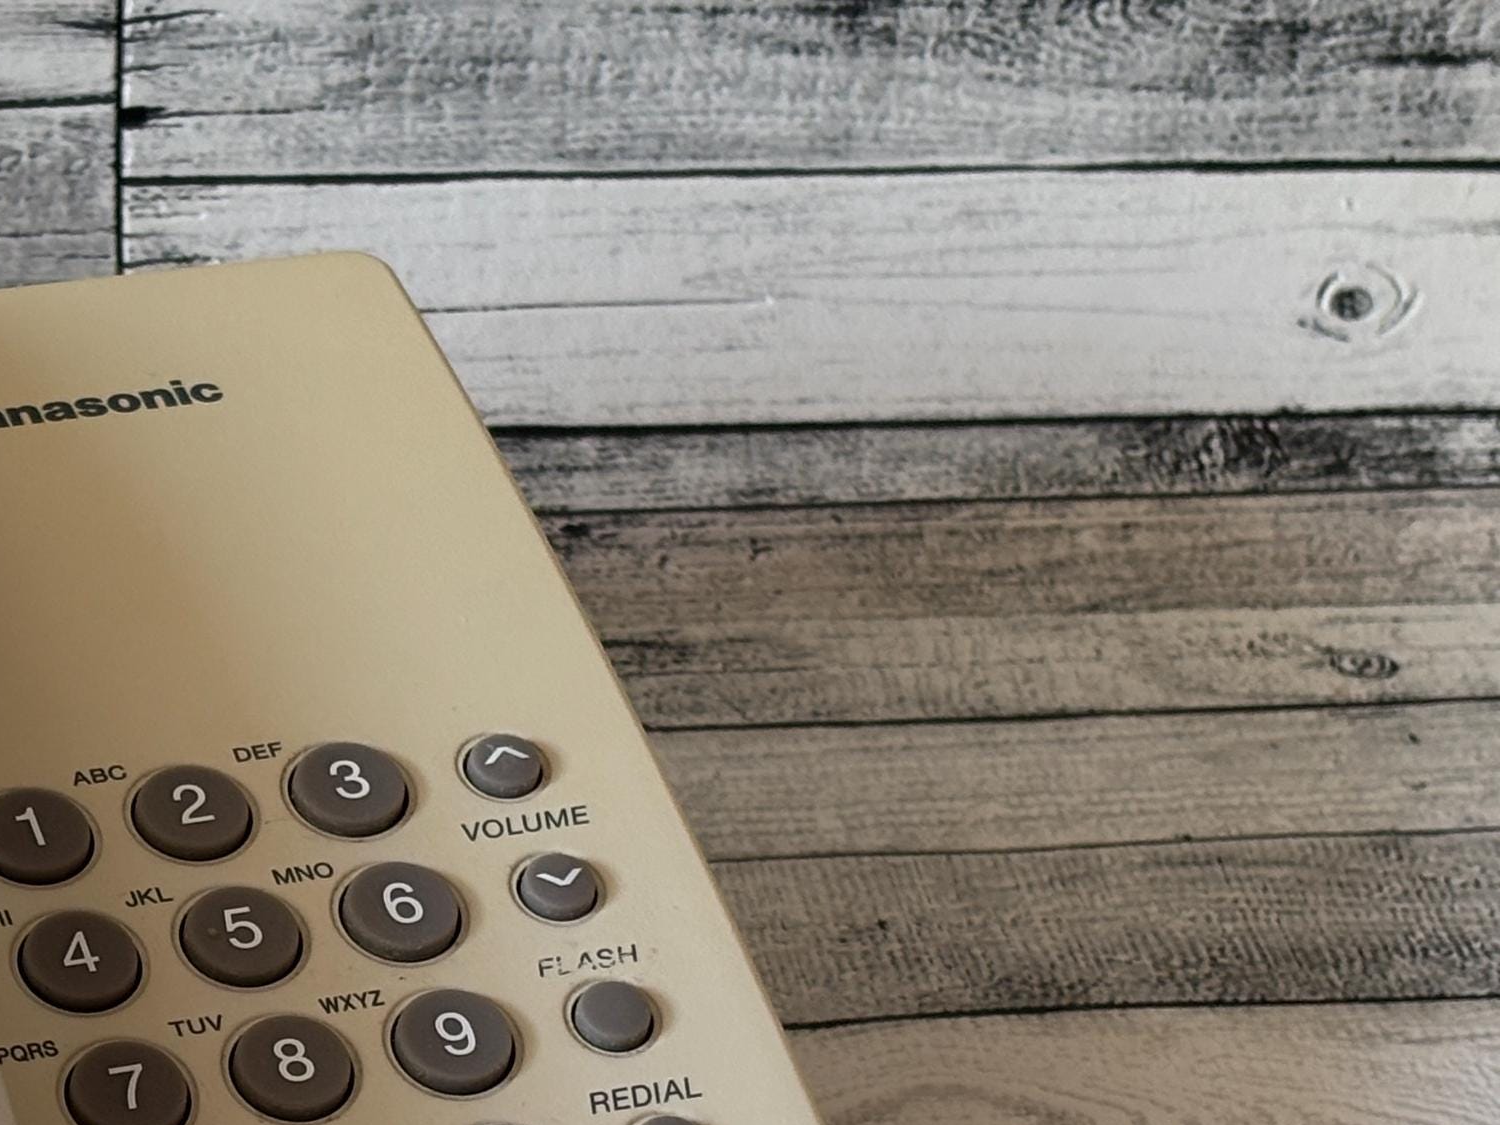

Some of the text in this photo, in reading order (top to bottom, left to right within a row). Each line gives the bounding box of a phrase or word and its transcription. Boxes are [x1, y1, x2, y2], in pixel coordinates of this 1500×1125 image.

[233, 742, 281, 762] DEF
[74, 765, 126, 786] ABC
[330, 761, 369, 798] 3
[173, 785, 214, 824] 2
[16, 807, 45, 845] 1
[461, 806, 589, 841] VOLUME
[272, 863, 333, 885] MNO
[126, 888, 173, 907] JKL
[384, 883, 423, 923] 6
[224, 907, 262, 948] 5
[64, 932, 99, 971] 4
[319, 990, 385, 1013] WXYZ
[169, 1015, 221, 1036] TUV
[435, 1013, 475, 1055] 9
[274, 1039, 314, 1081] 8
[109, 1064, 142, 1109] 7
[590, 1077, 702, 1114] REDIAL
